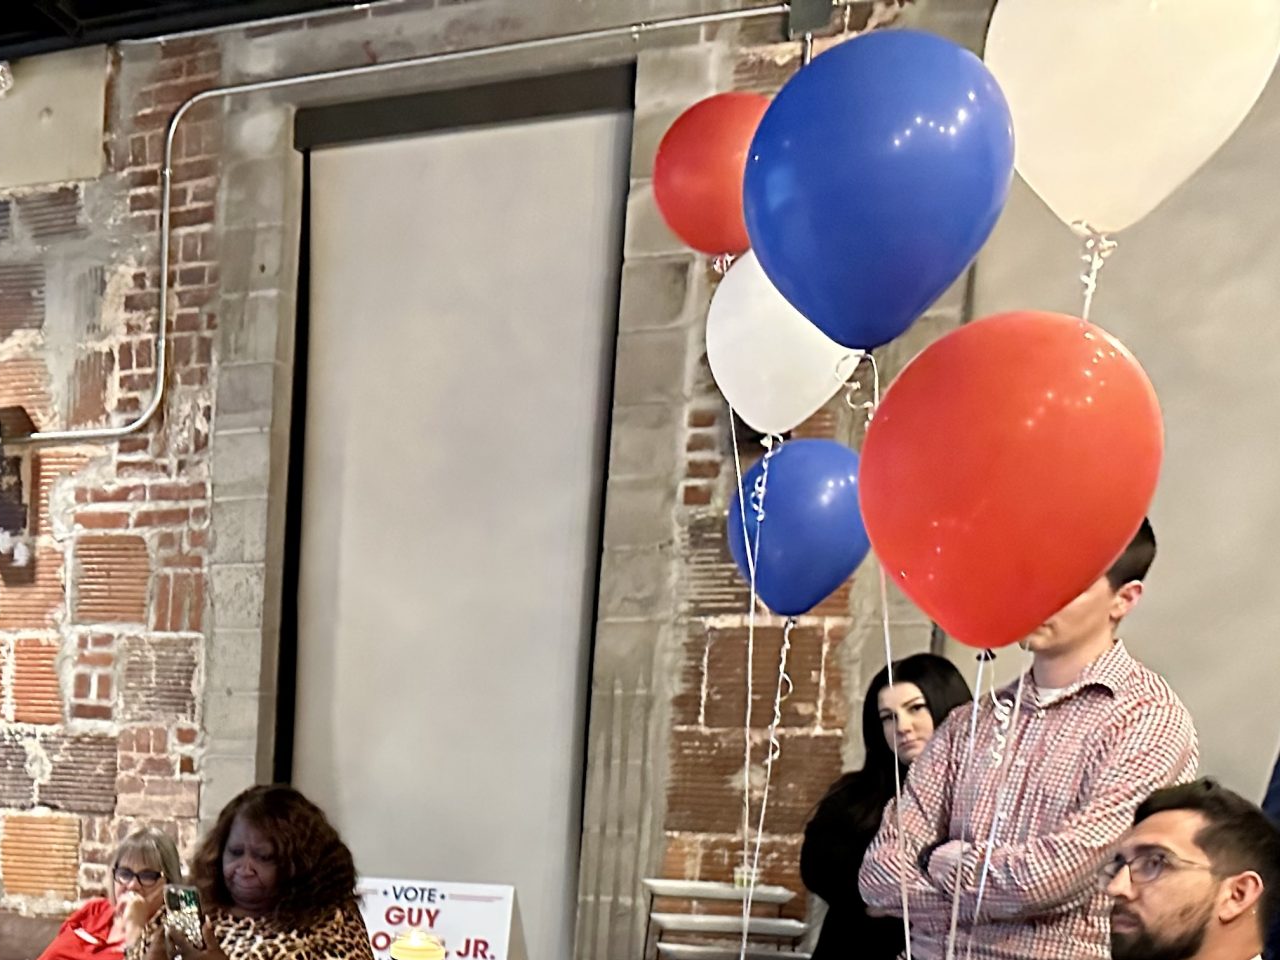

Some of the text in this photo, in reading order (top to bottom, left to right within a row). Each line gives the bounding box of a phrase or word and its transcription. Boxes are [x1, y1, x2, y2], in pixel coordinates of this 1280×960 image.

[392, 885, 437, 903] VOTE
[385, 906, 440, 929] GUY
[456, 938, 496, 960] JR.
